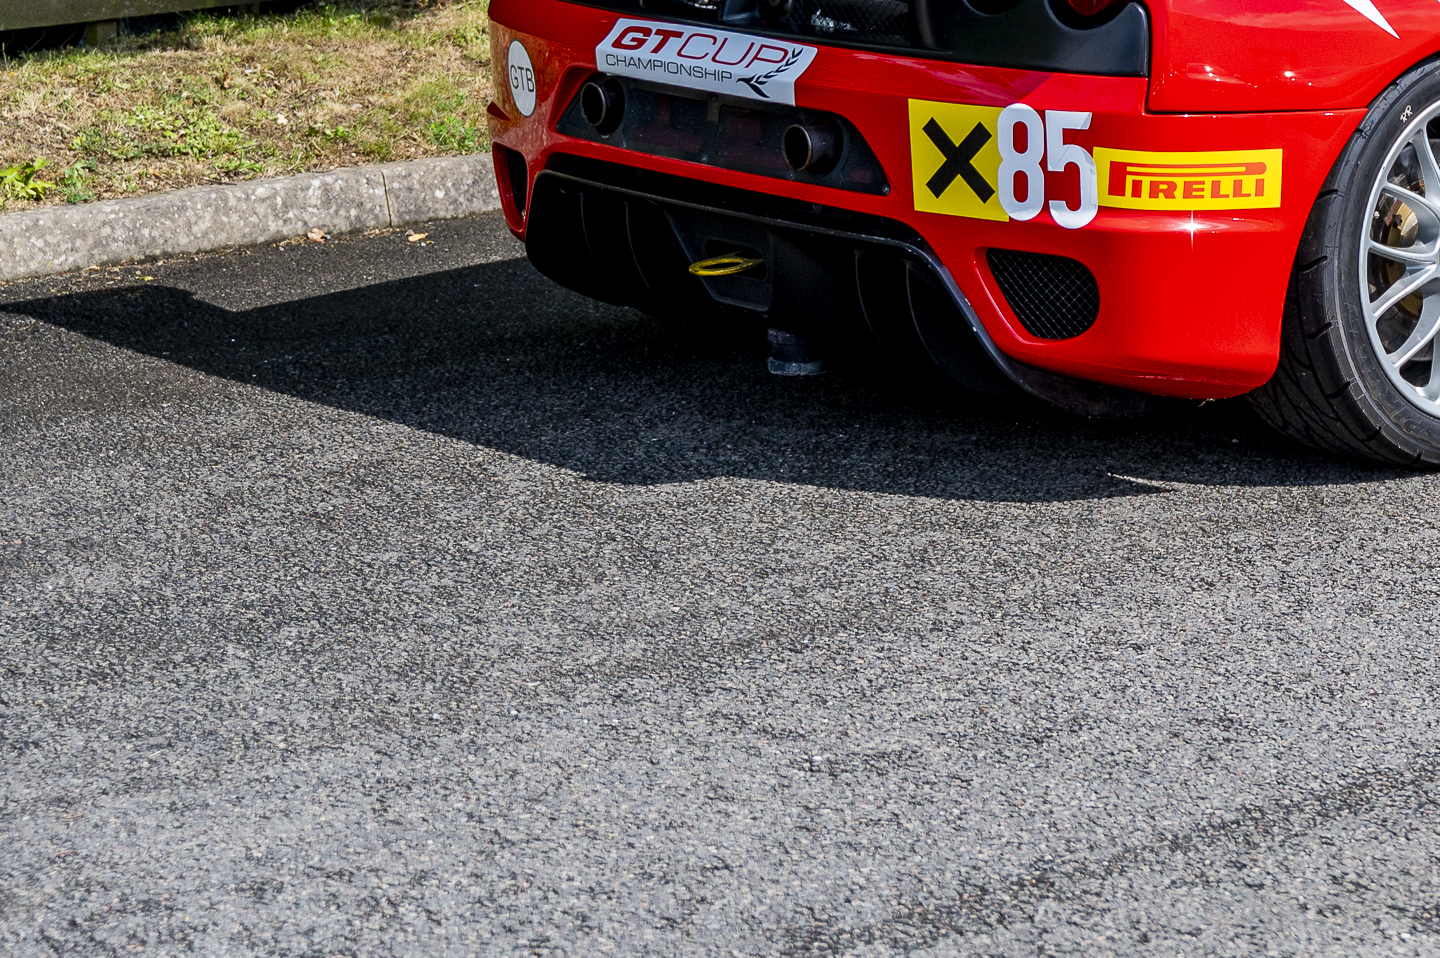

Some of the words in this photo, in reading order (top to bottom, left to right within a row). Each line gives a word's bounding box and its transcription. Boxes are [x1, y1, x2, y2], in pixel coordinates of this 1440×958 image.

[509, 64, 535, 93] GTB
[605, 53, 733, 83] CHAMPIONSHIP
[996, 102, 1099, 230] 85
[1107, 160, 1268, 200] PIRELLI
